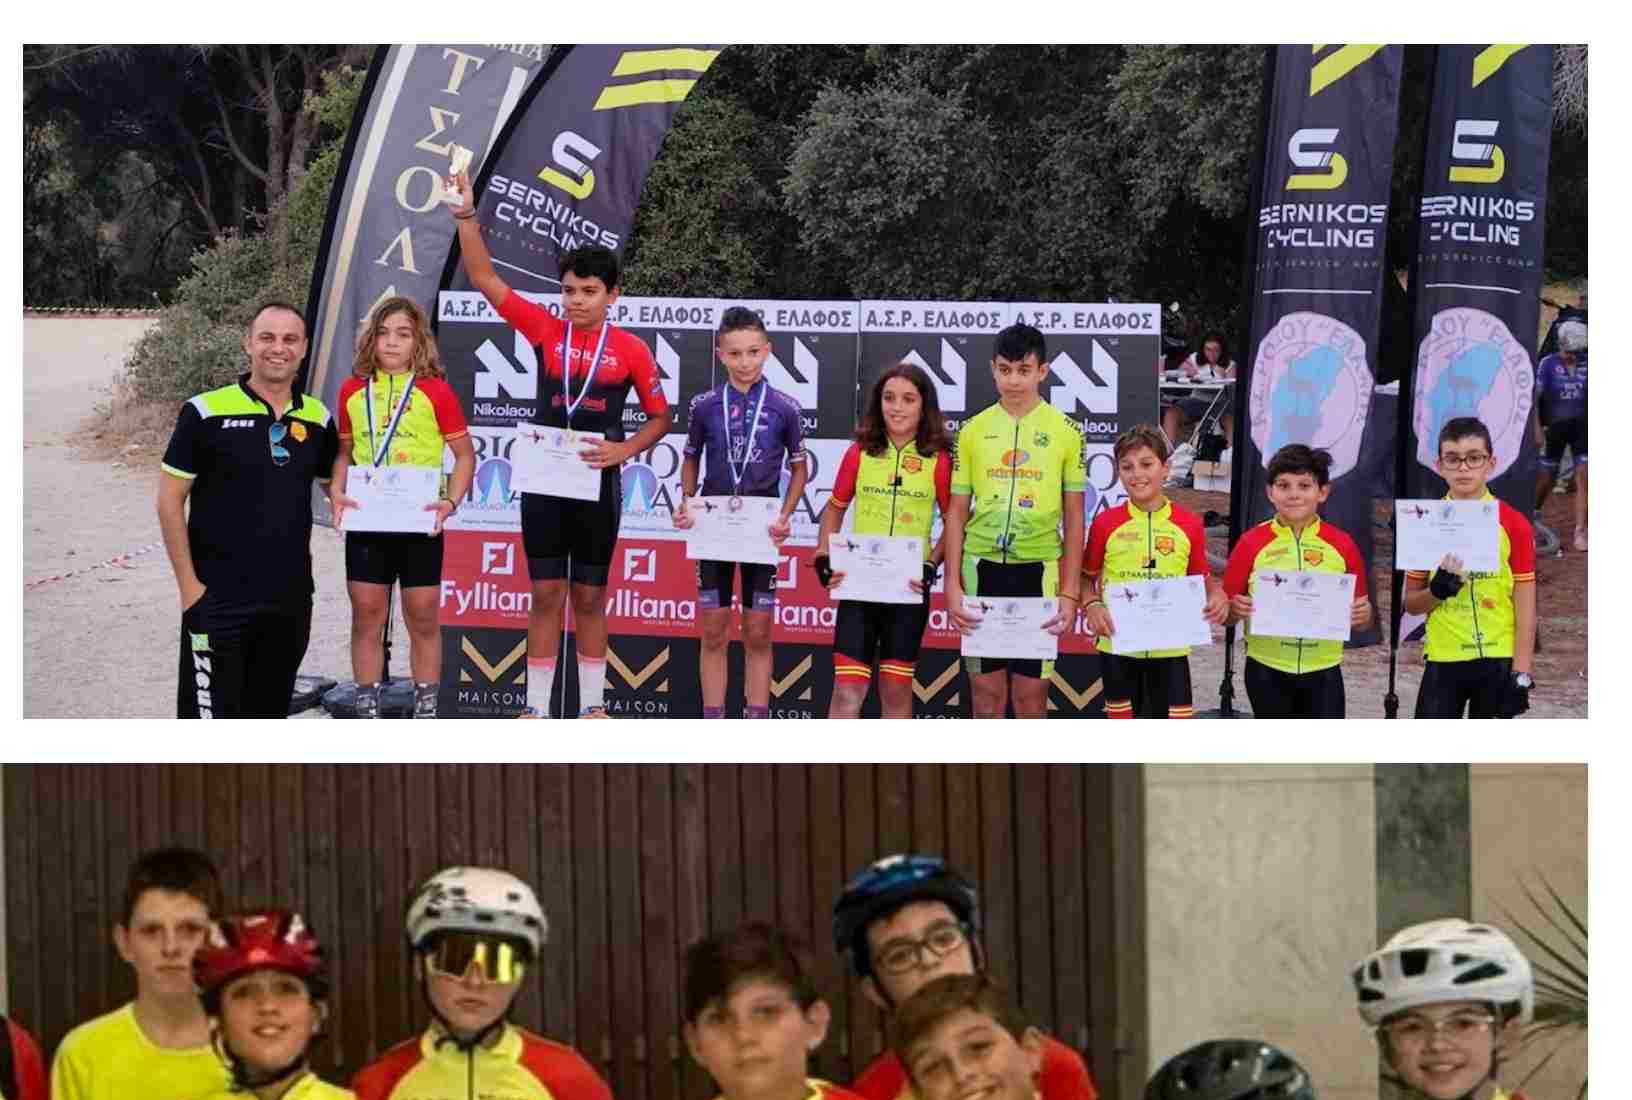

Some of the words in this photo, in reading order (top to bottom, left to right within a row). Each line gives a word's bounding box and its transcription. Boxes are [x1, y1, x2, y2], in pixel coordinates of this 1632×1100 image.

[488, 174, 620, 251] SERNIKOS
[639, 306, 714, 325] ΕΛΑΦΟΣ
[775, 309, 852, 328] ΕΛΑΦΟΣ
[865, 311, 918, 329] Α.Σ.Ρ.
[923, 311, 1001, 329] ΕΛΑΦΟΣ
[1073, 311, 1154, 330] ΕΛΑΦΟΣ
[472, 402, 537, 418] Nikolaou
[439, 580, 533, 616] Fyllian
[605, 588, 696, 618] lliana
